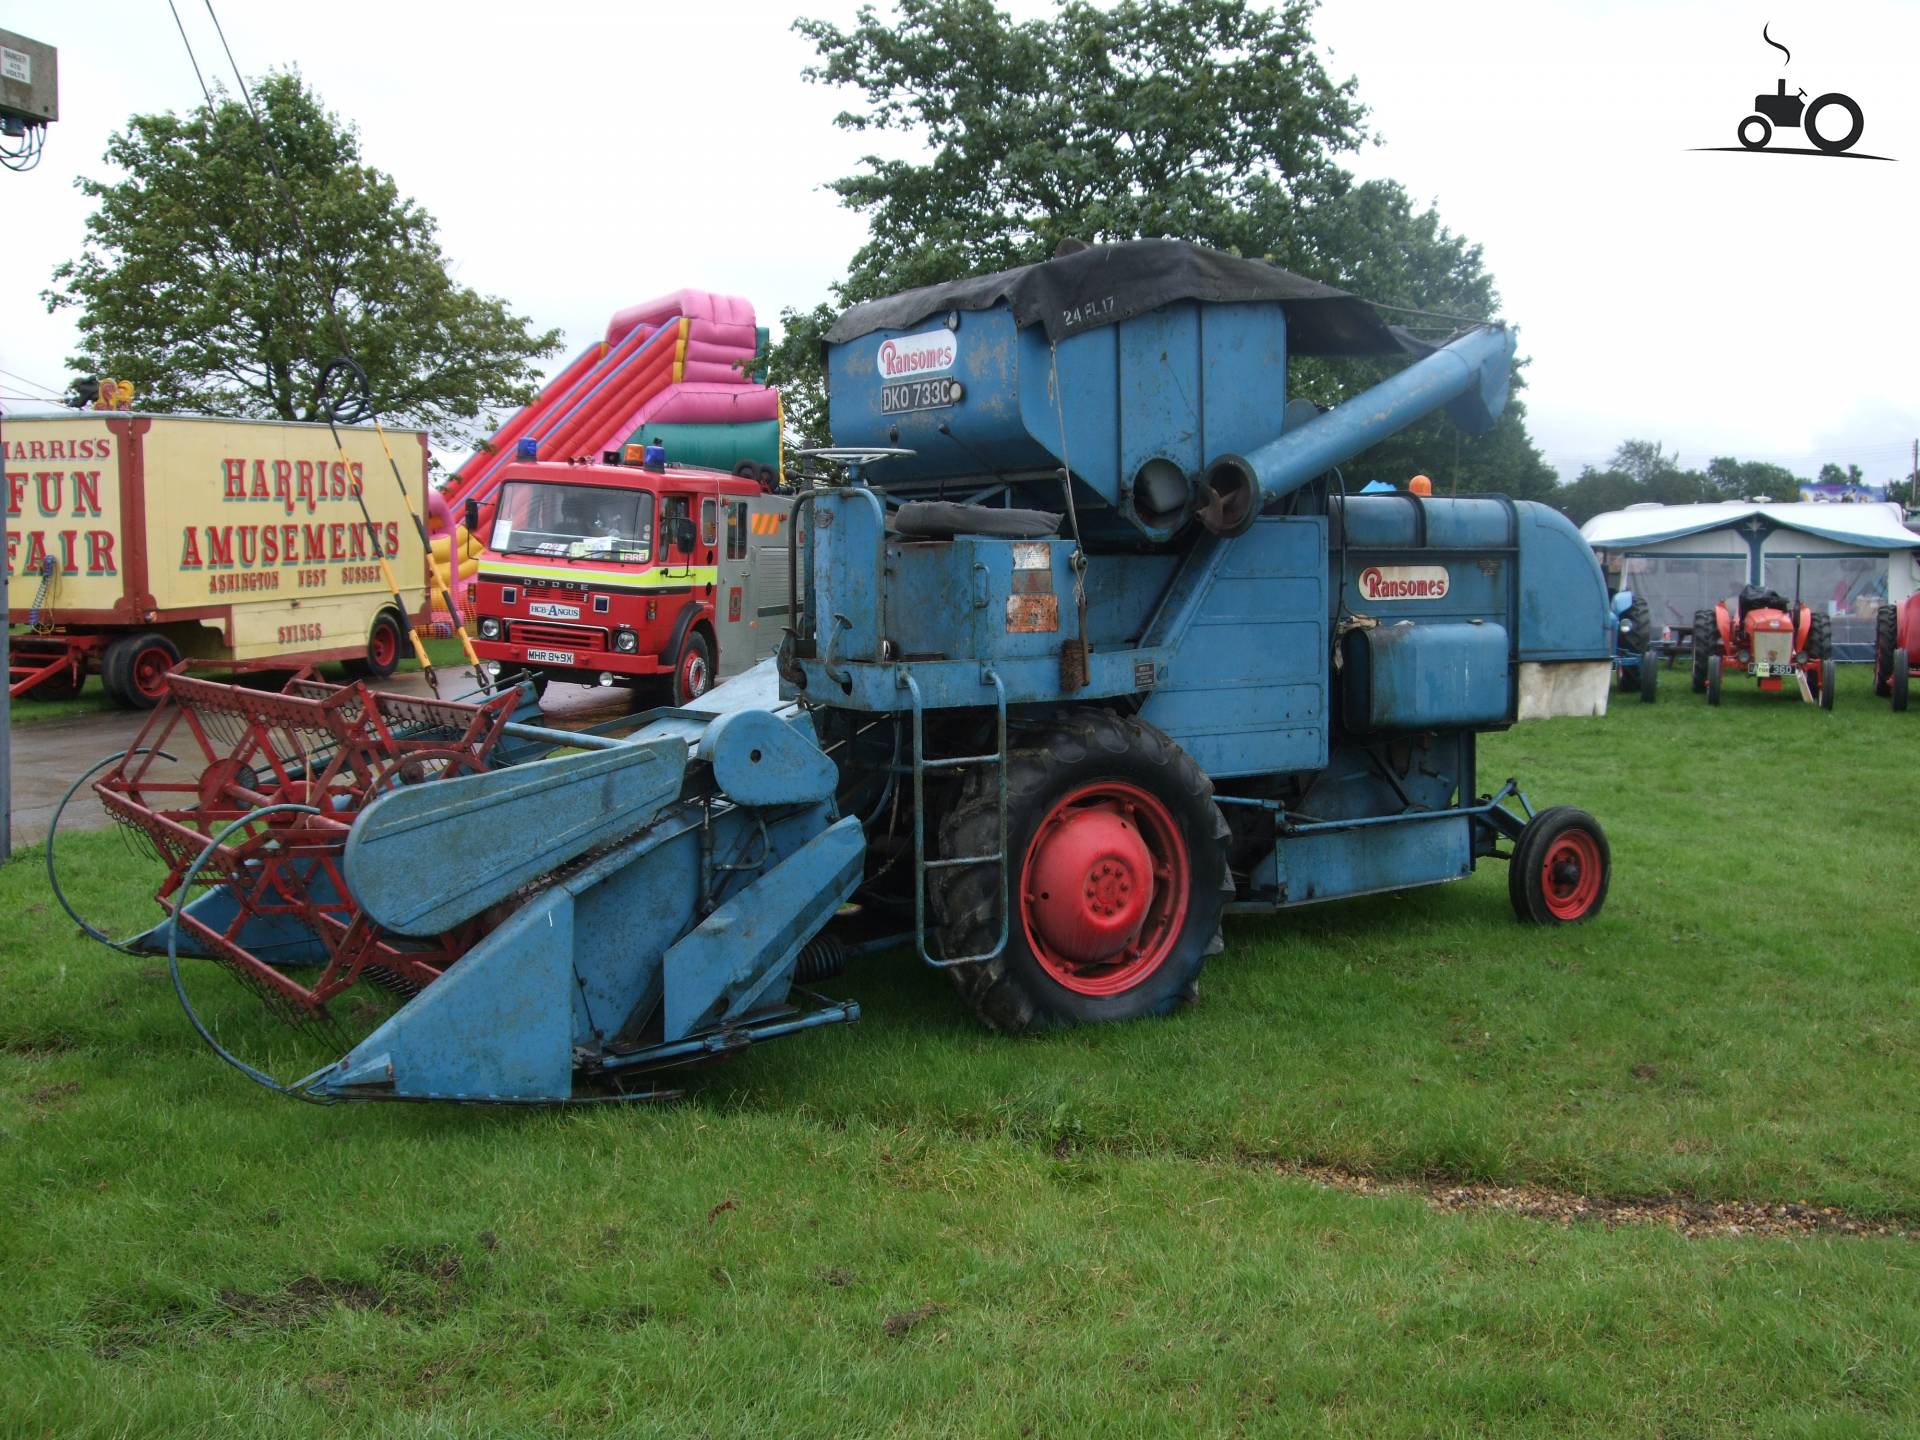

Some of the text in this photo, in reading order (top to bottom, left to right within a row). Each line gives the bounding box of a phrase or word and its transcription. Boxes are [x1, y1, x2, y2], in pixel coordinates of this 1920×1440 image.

[1063, 307, 1082, 326] 24
[880, 340, 953, 375] Ransomes
[883, 380, 950, 411] DKO 733C
[6, 471, 102, 517] FUN
[7, 530, 118, 576] FAIR
[180, 521, 400, 571] AMUSEMENTS
[209, 565, 381, 594] ASHINGTON WEST SUSSEX
[523, 578, 589, 591] DODGE
[1363, 567, 1445, 598] Ransomes
[277, 623, 322, 645] SWINGS
[528, 650, 547, 661] MHR
